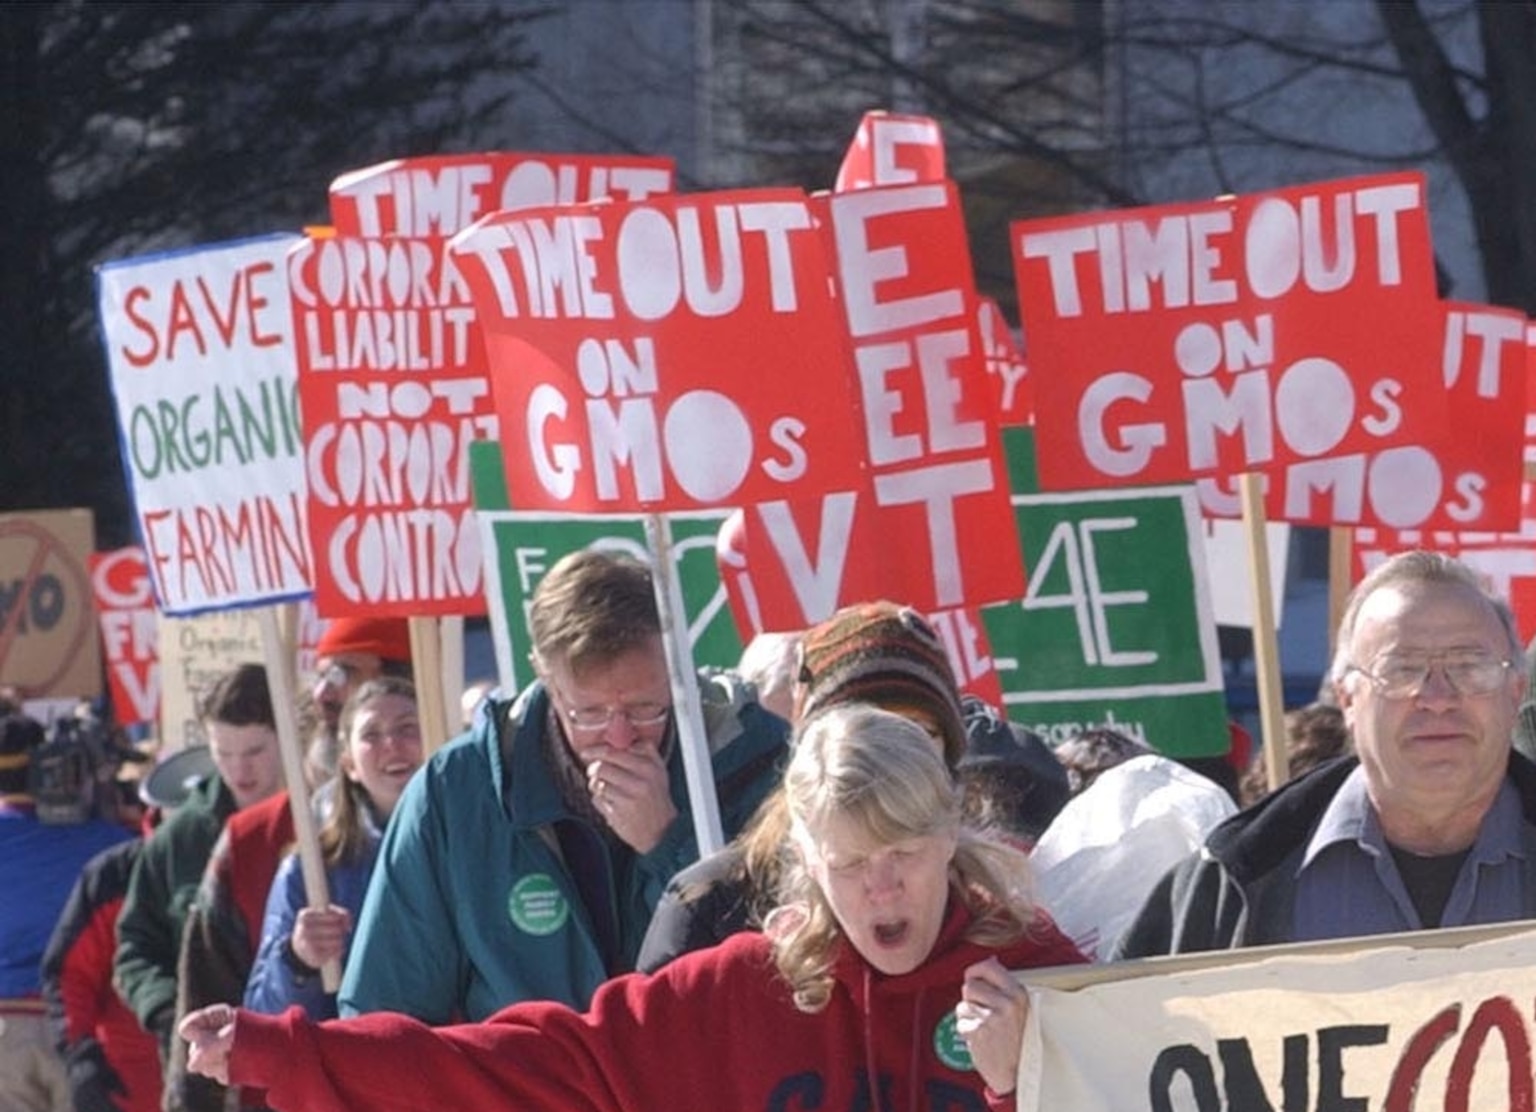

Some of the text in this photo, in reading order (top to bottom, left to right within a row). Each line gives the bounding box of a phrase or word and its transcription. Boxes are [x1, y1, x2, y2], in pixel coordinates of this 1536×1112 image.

[334, 165, 493, 239] TIME
[1022, 182, 1420, 319] TIME OUT
[121, 261, 284, 368] SAVE
[290, 238, 473, 308] CORPORA
[453, 201, 811, 322] TIME OUT
[304, 307, 477, 372] LIABILIT
[576, 336, 659, 398] ON
[1175, 314, 1275, 377] ON
[130, 375, 302, 482] ORGANI
[336, 376, 489, 420] NOT
[526, 383, 809, 503] GMOs
[1078, 356, 1403, 478] GMOs
[144, 491, 315, 609] FARMIN
[329, 508, 485, 604] CONTRO
[756, 458, 995, 626] VT
